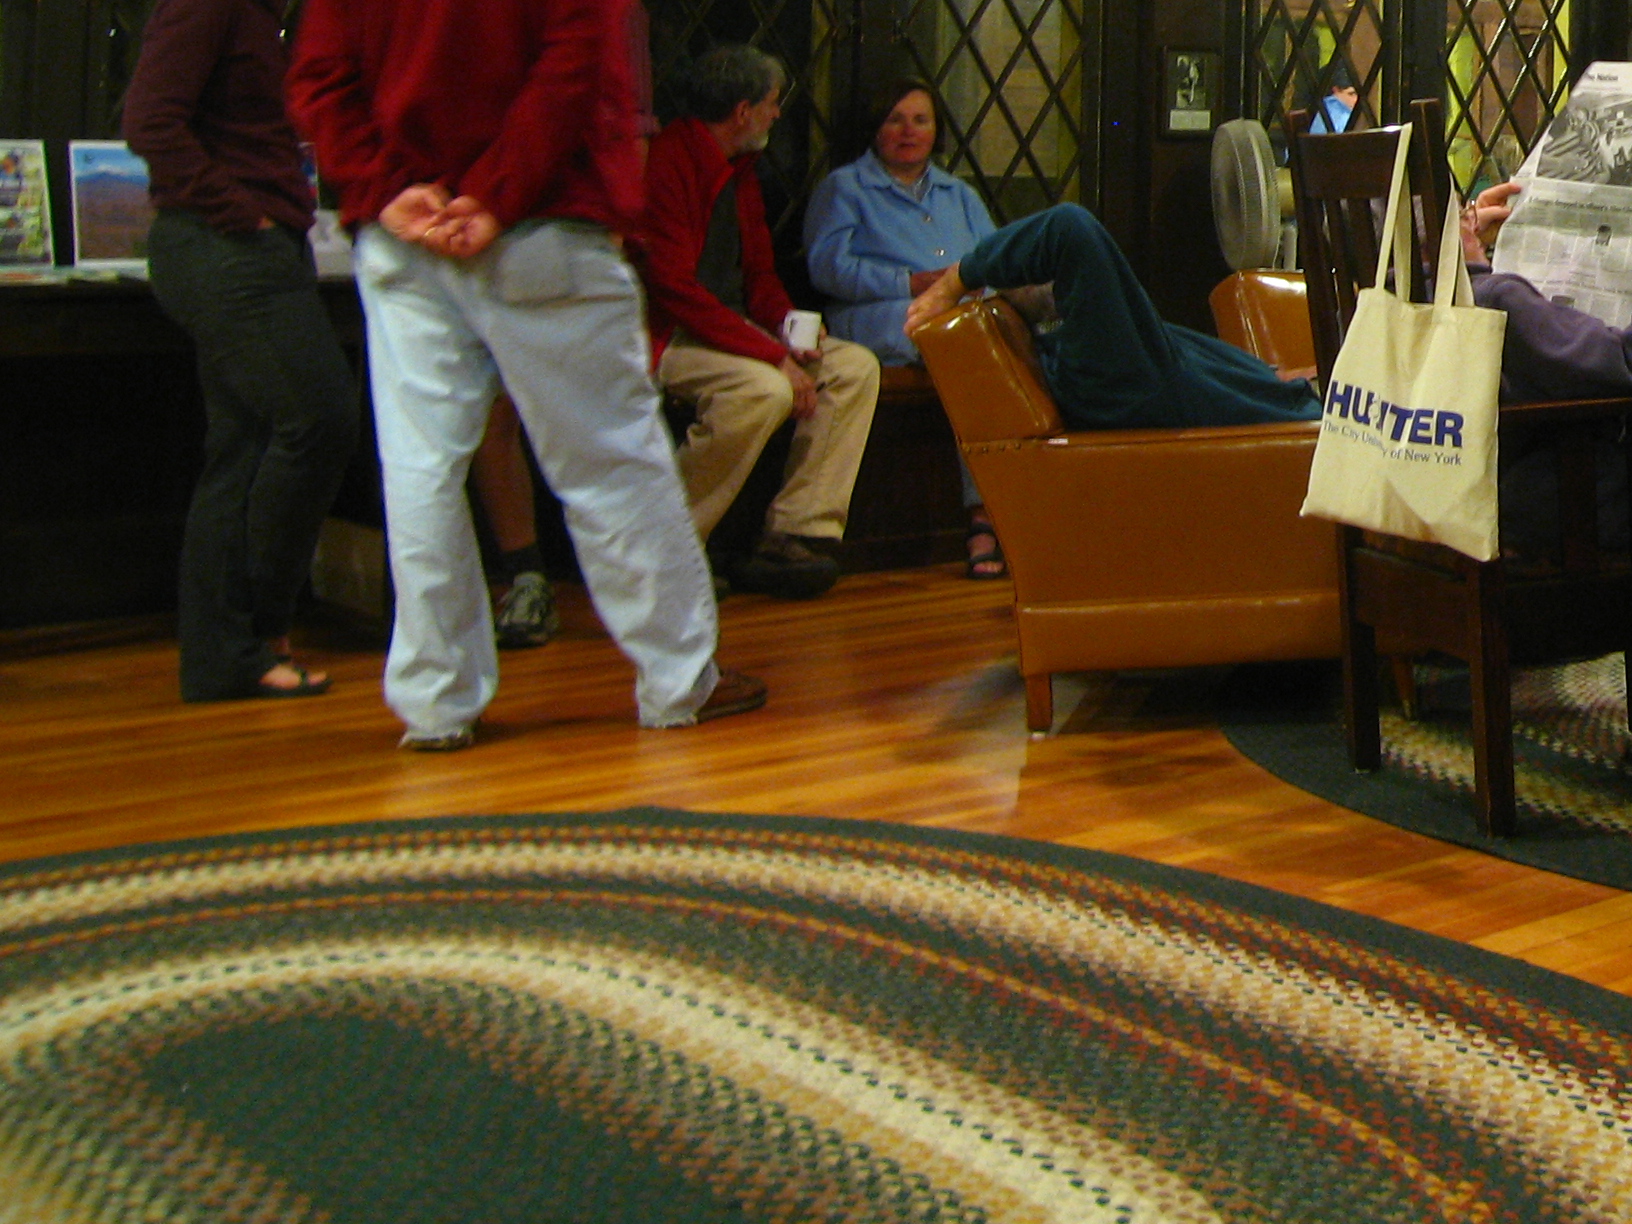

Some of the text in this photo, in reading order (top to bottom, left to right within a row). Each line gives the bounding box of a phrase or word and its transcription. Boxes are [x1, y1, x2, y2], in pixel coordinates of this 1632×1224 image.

[1324, 420, 1339, 432] The
[1341, 425, 1360, 442] City
[1390, 447, 1402, 459] of
[1404, 449, 1430, 462] New
[1434, 451, 1461, 465] York
